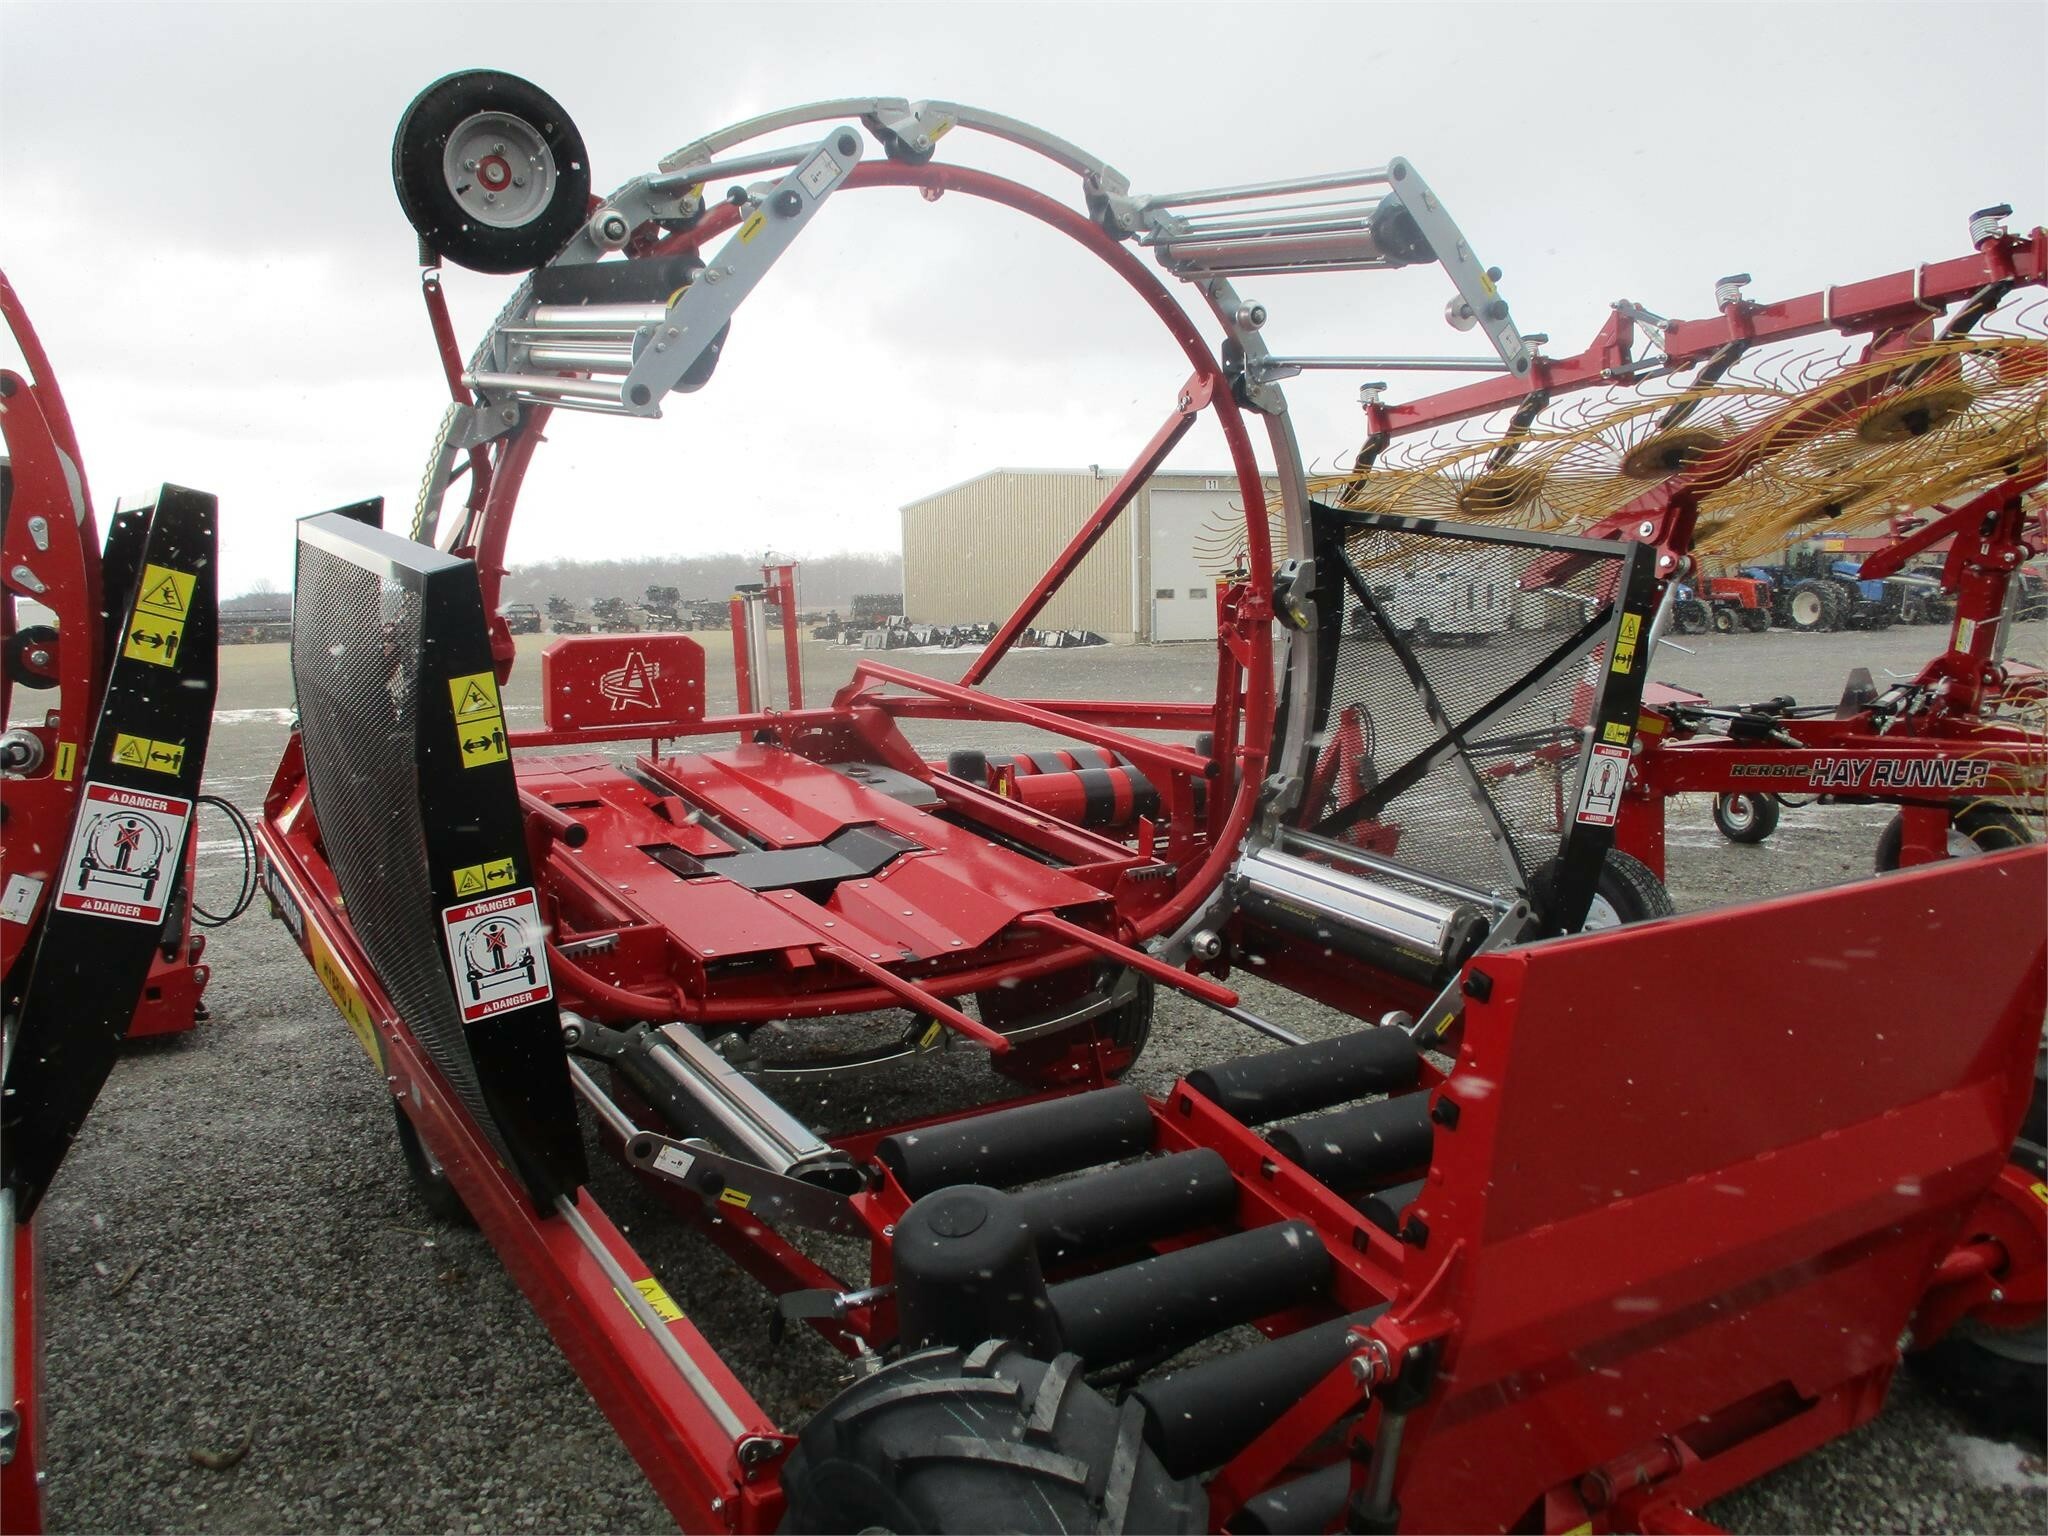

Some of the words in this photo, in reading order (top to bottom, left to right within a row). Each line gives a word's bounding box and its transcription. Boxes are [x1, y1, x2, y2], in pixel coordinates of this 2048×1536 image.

[1208, 480, 1217, 489] 11
[1605, 748, 1623, 757] DANGER
[1729, 764, 1809, 777] RCR812
[1809, 758, 1873, 787] HAY
[1869, 758, 1990, 788] RUNNER
[120, 793, 168, 811] DANGER
[93, 901, 141, 917] DANGER
[474, 897, 516, 914] DANGER
[492, 992, 533, 1011] DANGER
